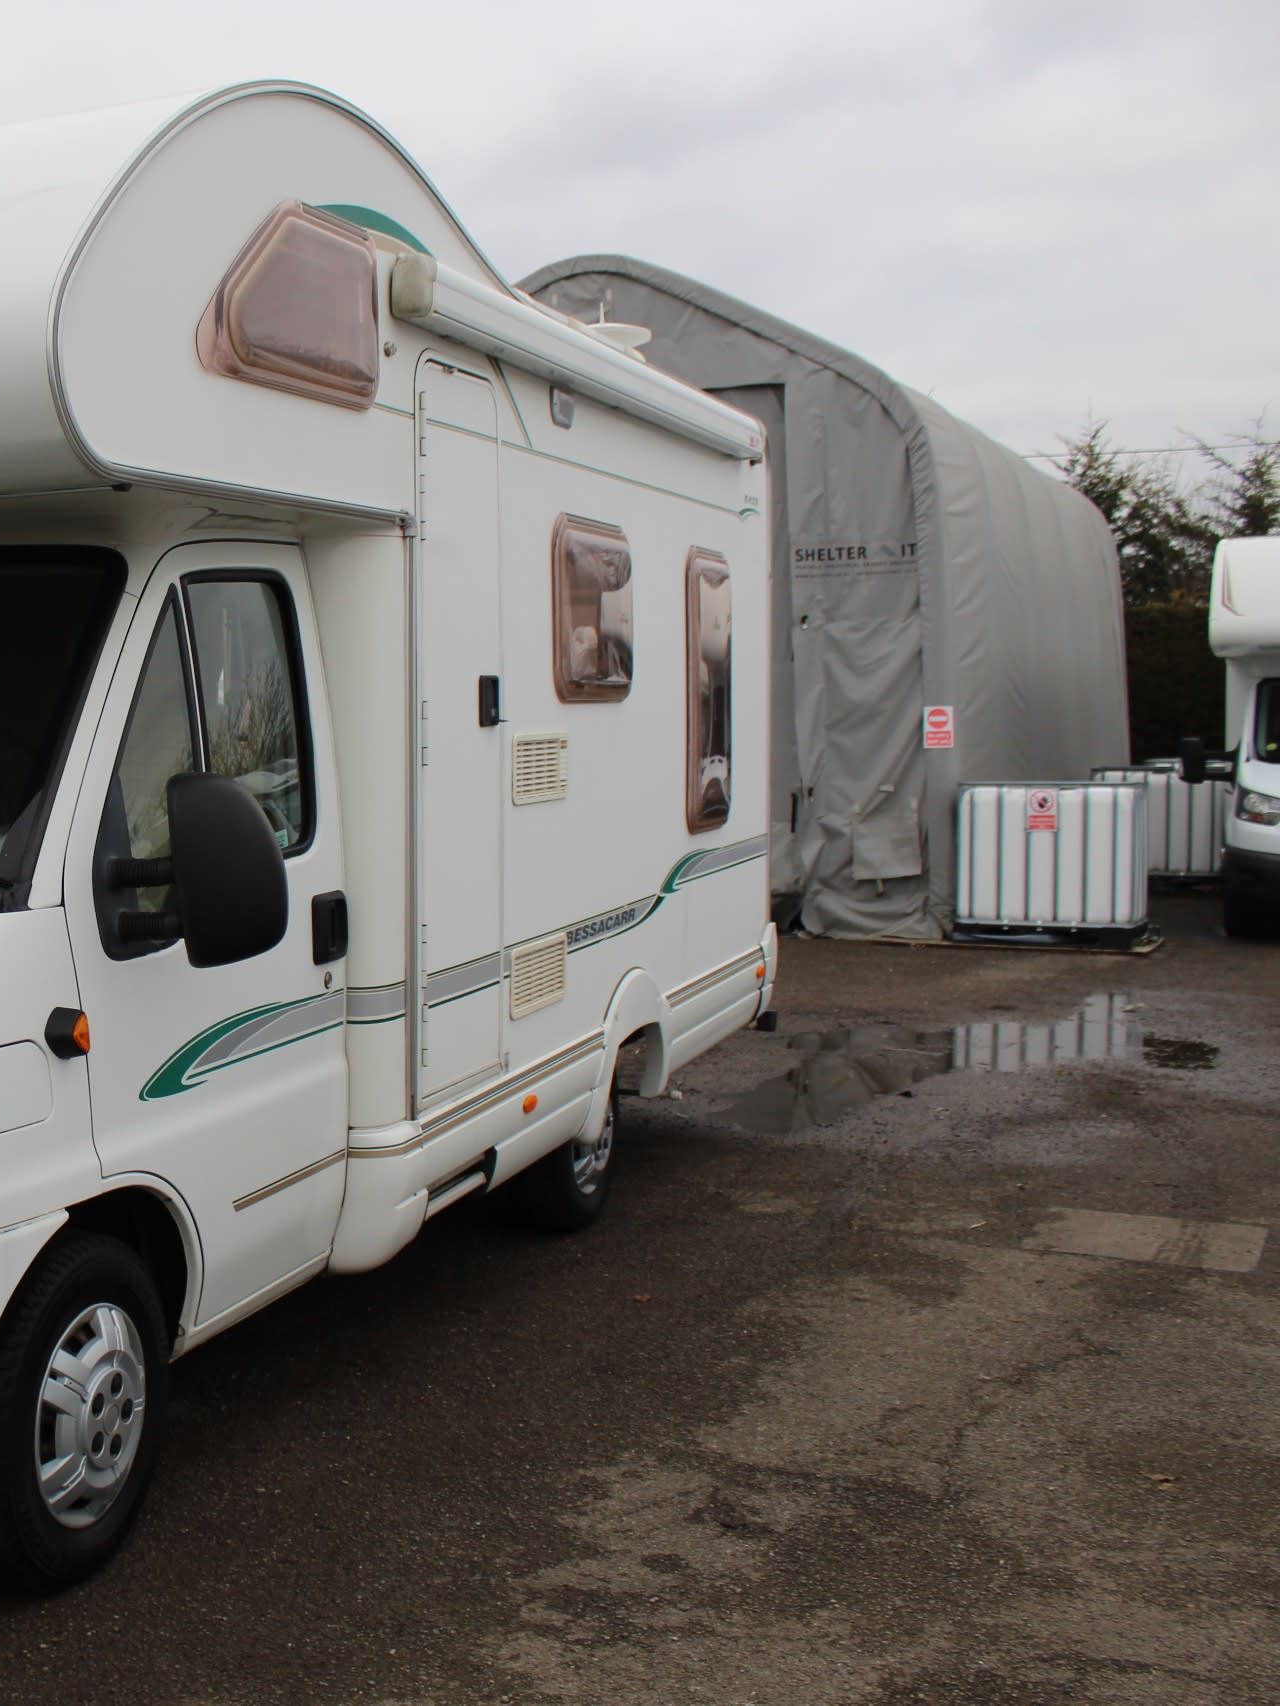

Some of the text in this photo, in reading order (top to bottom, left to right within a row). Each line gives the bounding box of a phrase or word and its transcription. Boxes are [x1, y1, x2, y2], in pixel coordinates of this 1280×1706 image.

[795, 542, 917, 562] SHELTER IT
[566, 908, 636, 946] BESSACARR
